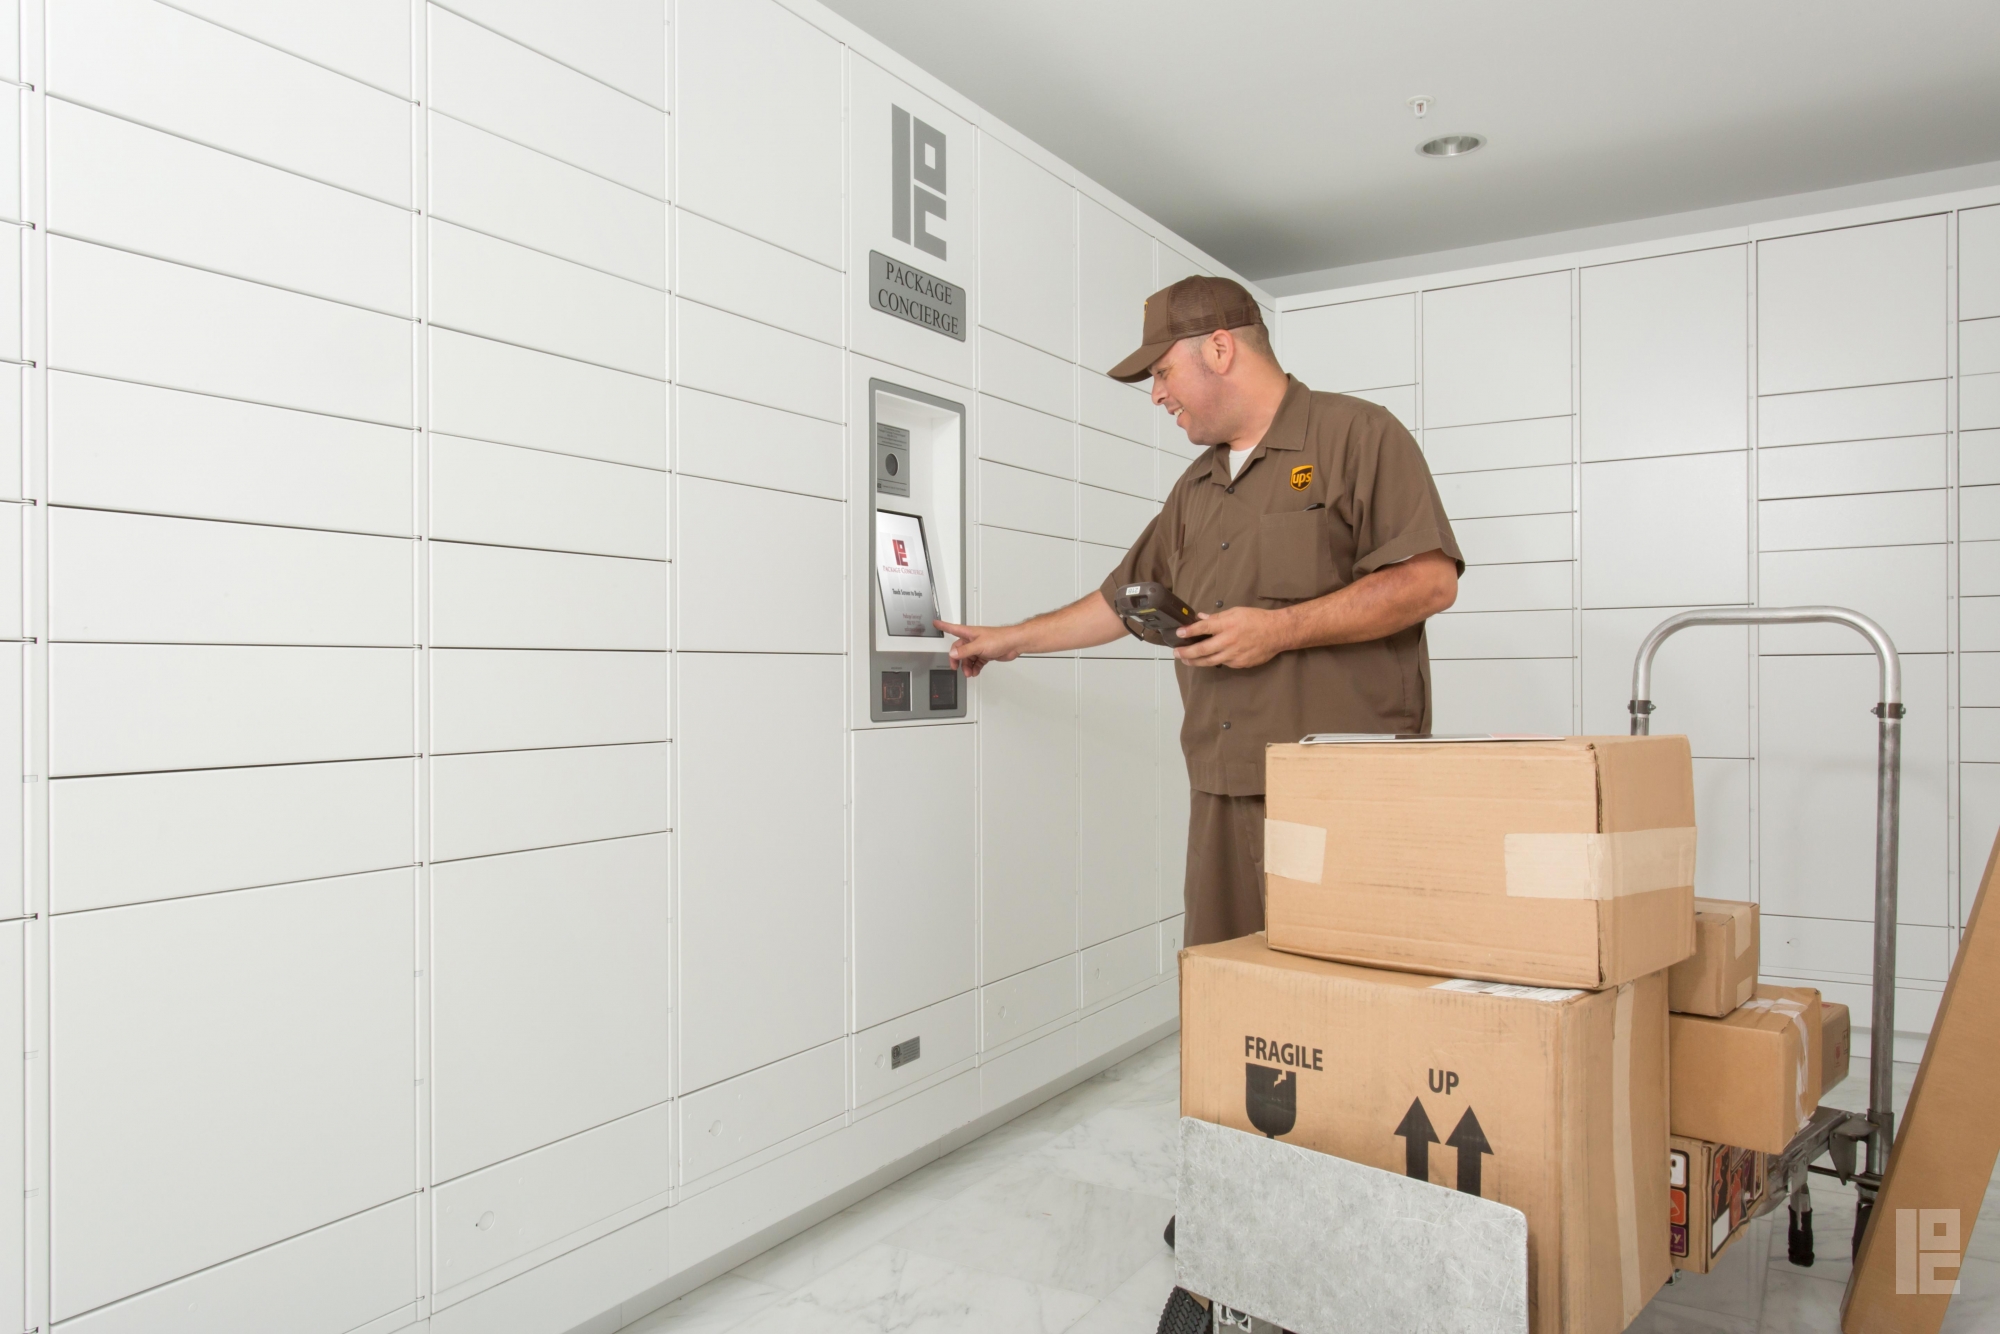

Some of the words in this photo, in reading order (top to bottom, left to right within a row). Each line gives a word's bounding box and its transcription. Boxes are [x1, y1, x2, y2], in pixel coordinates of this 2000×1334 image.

[886, 261, 952, 305] PACKAGE
[878, 289, 959, 335] CONCIERGE
[1292, 472, 1312, 487] ups
[1245, 1035, 1323, 1071] FRAGILE
[1428, 1068, 1460, 1095] UP
